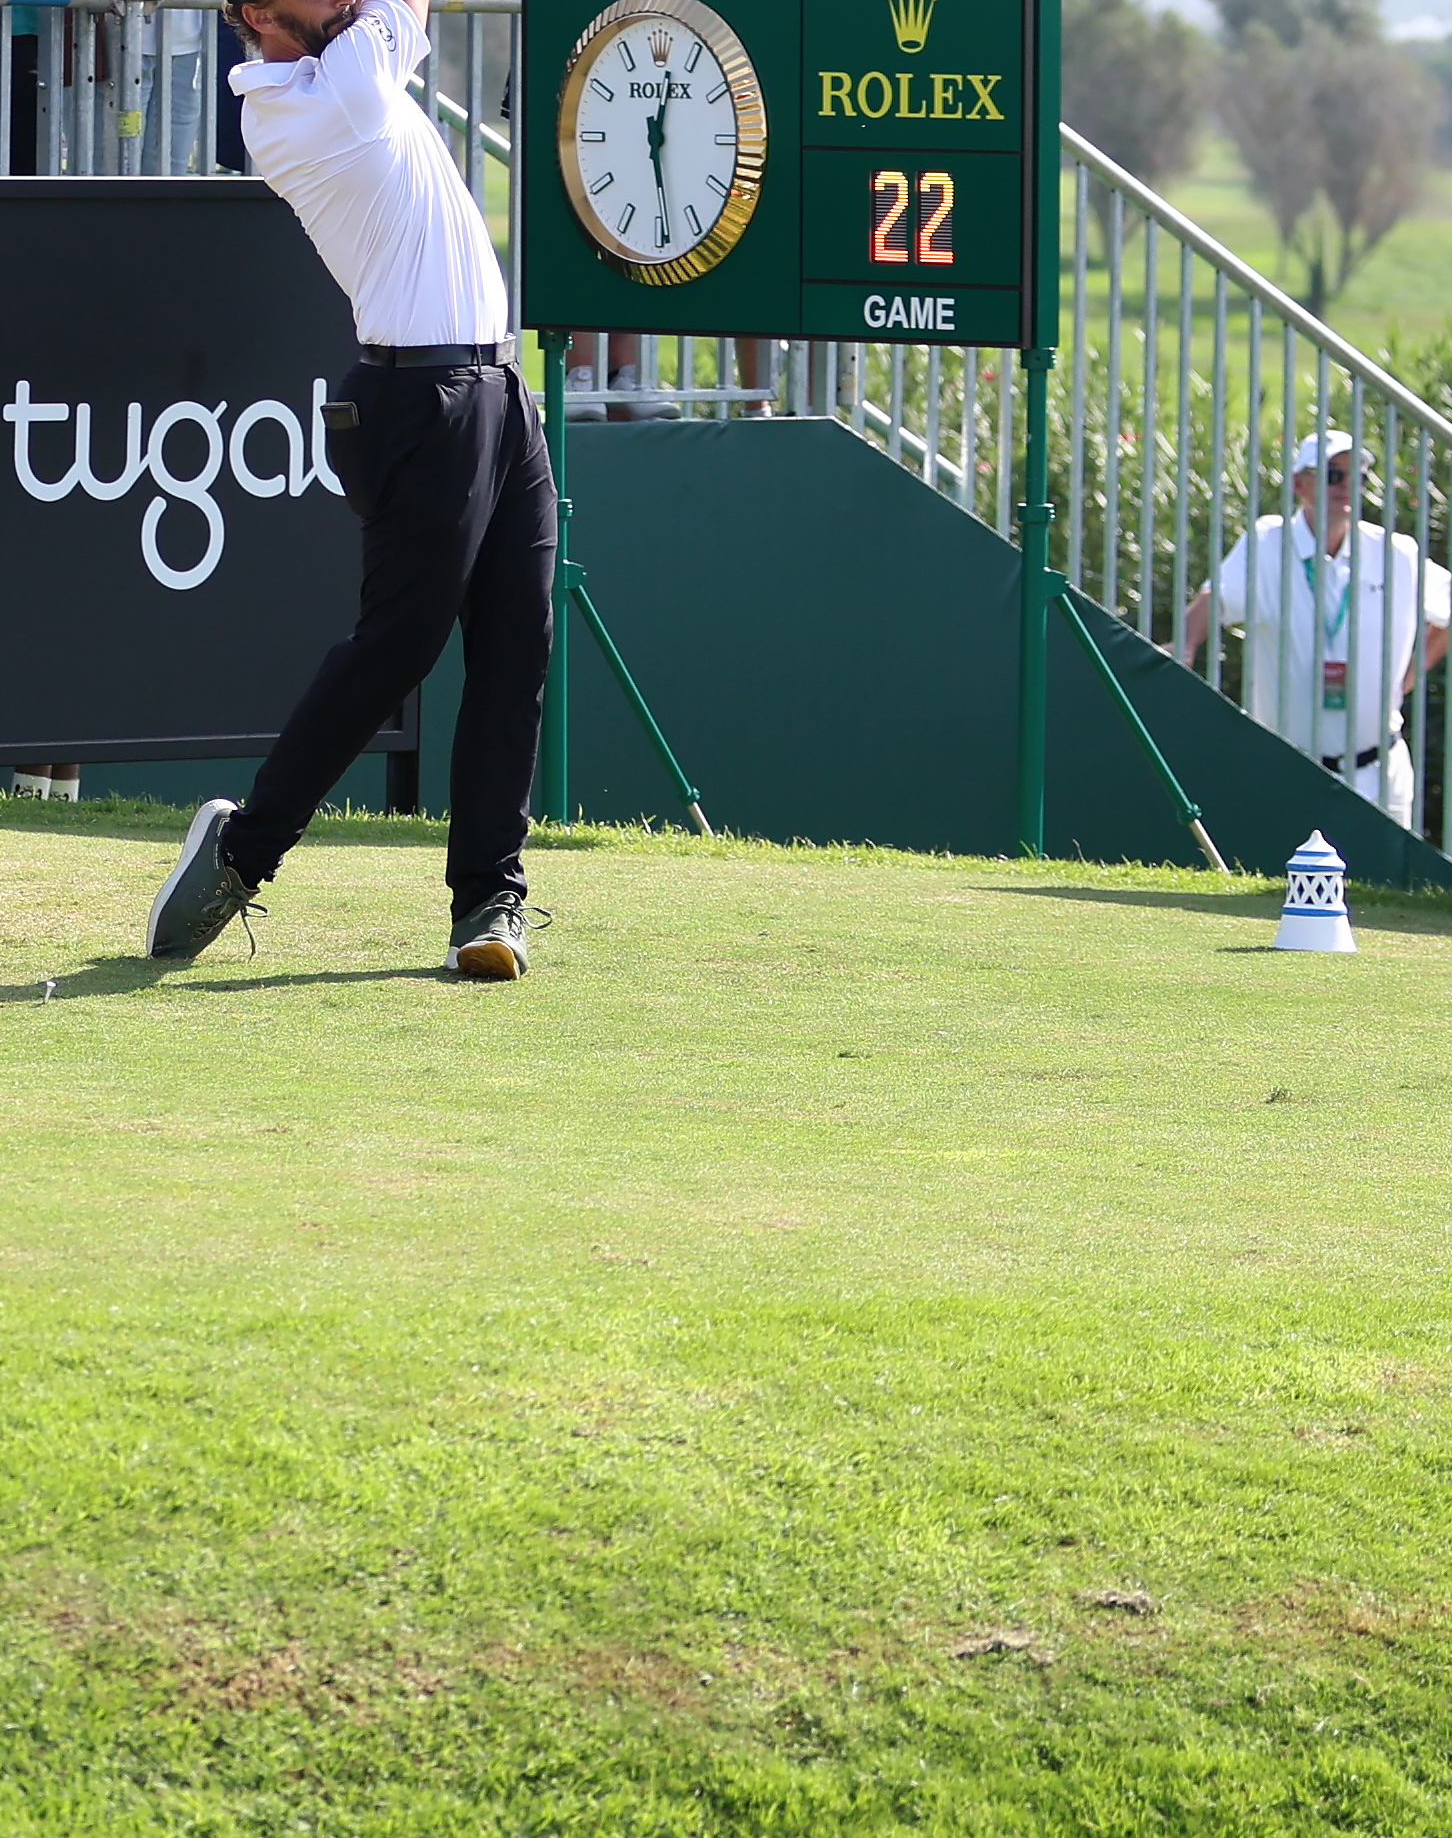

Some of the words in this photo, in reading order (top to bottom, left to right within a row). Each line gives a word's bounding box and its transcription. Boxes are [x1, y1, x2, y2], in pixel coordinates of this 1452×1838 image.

[629, 82, 692, 99] ROLEX
[818, 71, 1005, 120] ROLEX
[873, 170, 954, 265] 22
[863, 295, 955, 331] GAME
